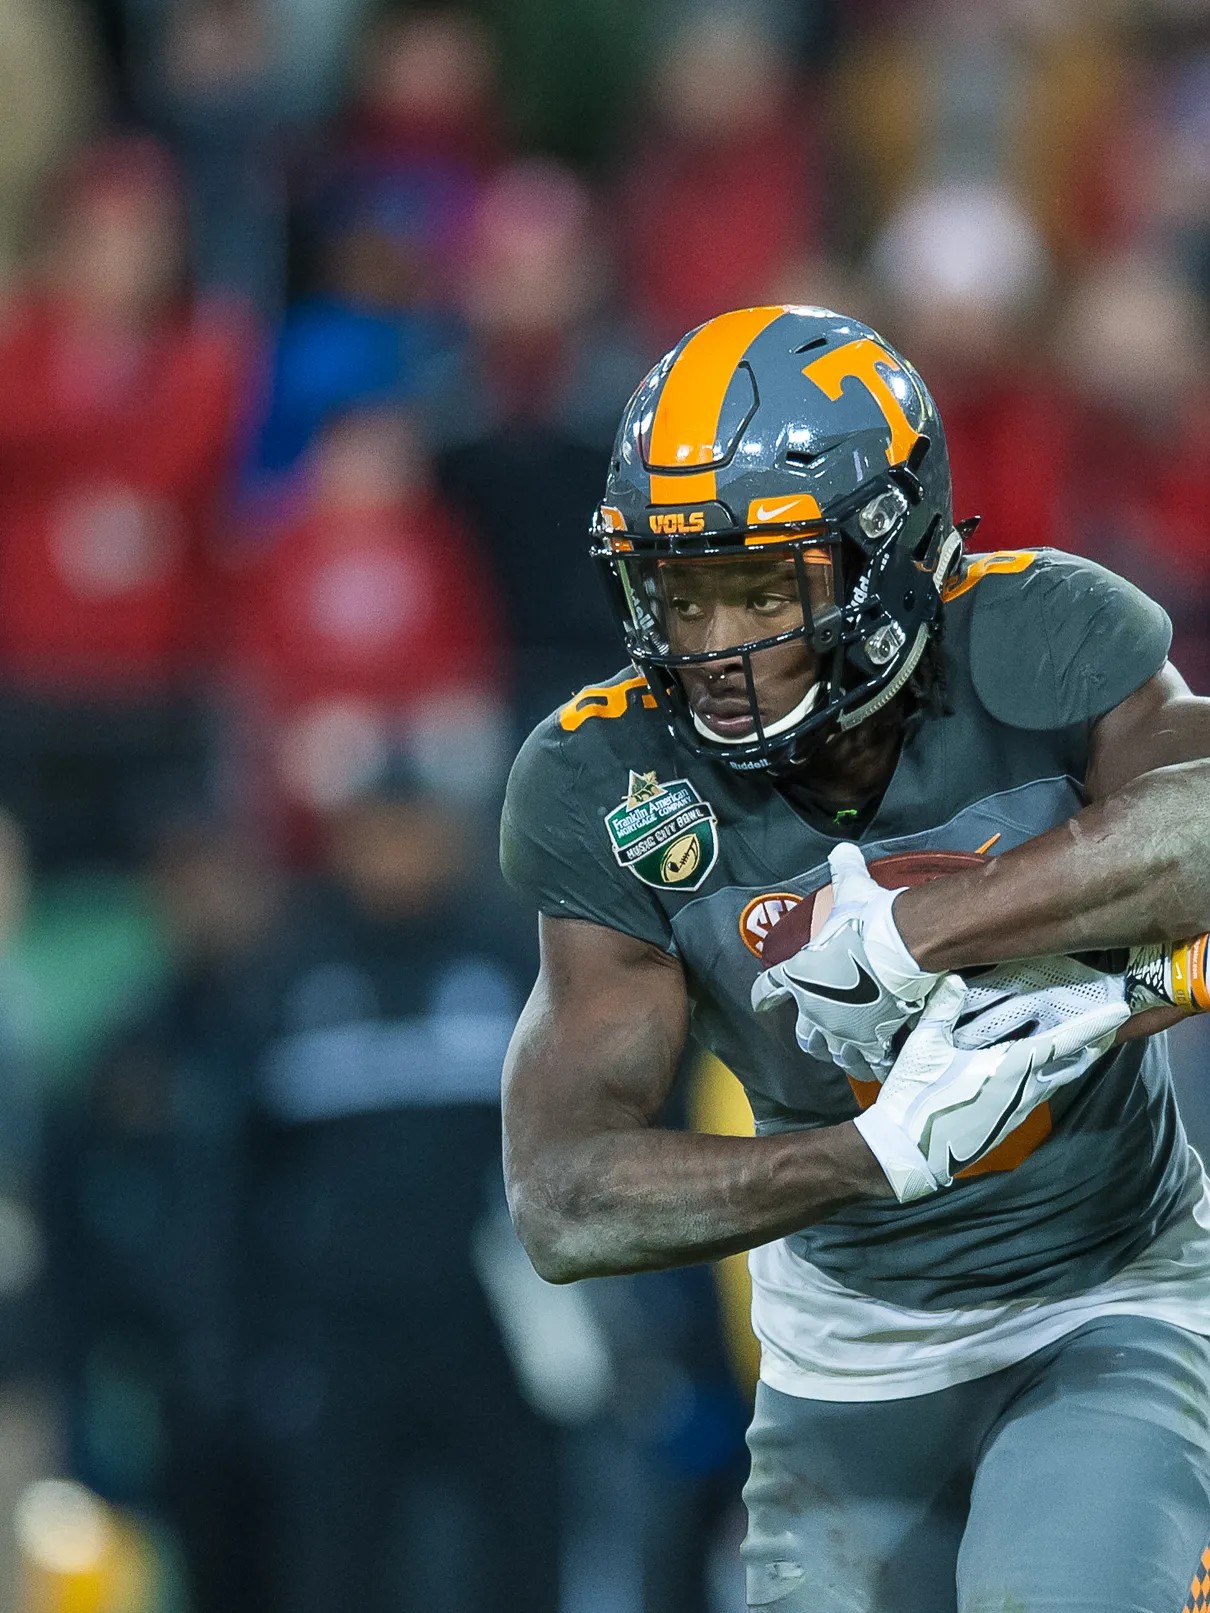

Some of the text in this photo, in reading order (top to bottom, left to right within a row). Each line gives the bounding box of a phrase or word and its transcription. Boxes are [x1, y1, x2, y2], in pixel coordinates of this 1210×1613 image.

[802, 338, 919, 467] T
[649, 511, 705, 535] VOLS
[729, 759, 770, 770] Riddell
[612, 788, 689, 831] Franklin American
[617, 796, 693, 839] MORTGAGE COMPANY
[626, 808, 705, 860] MUSIC CITY BOWL
